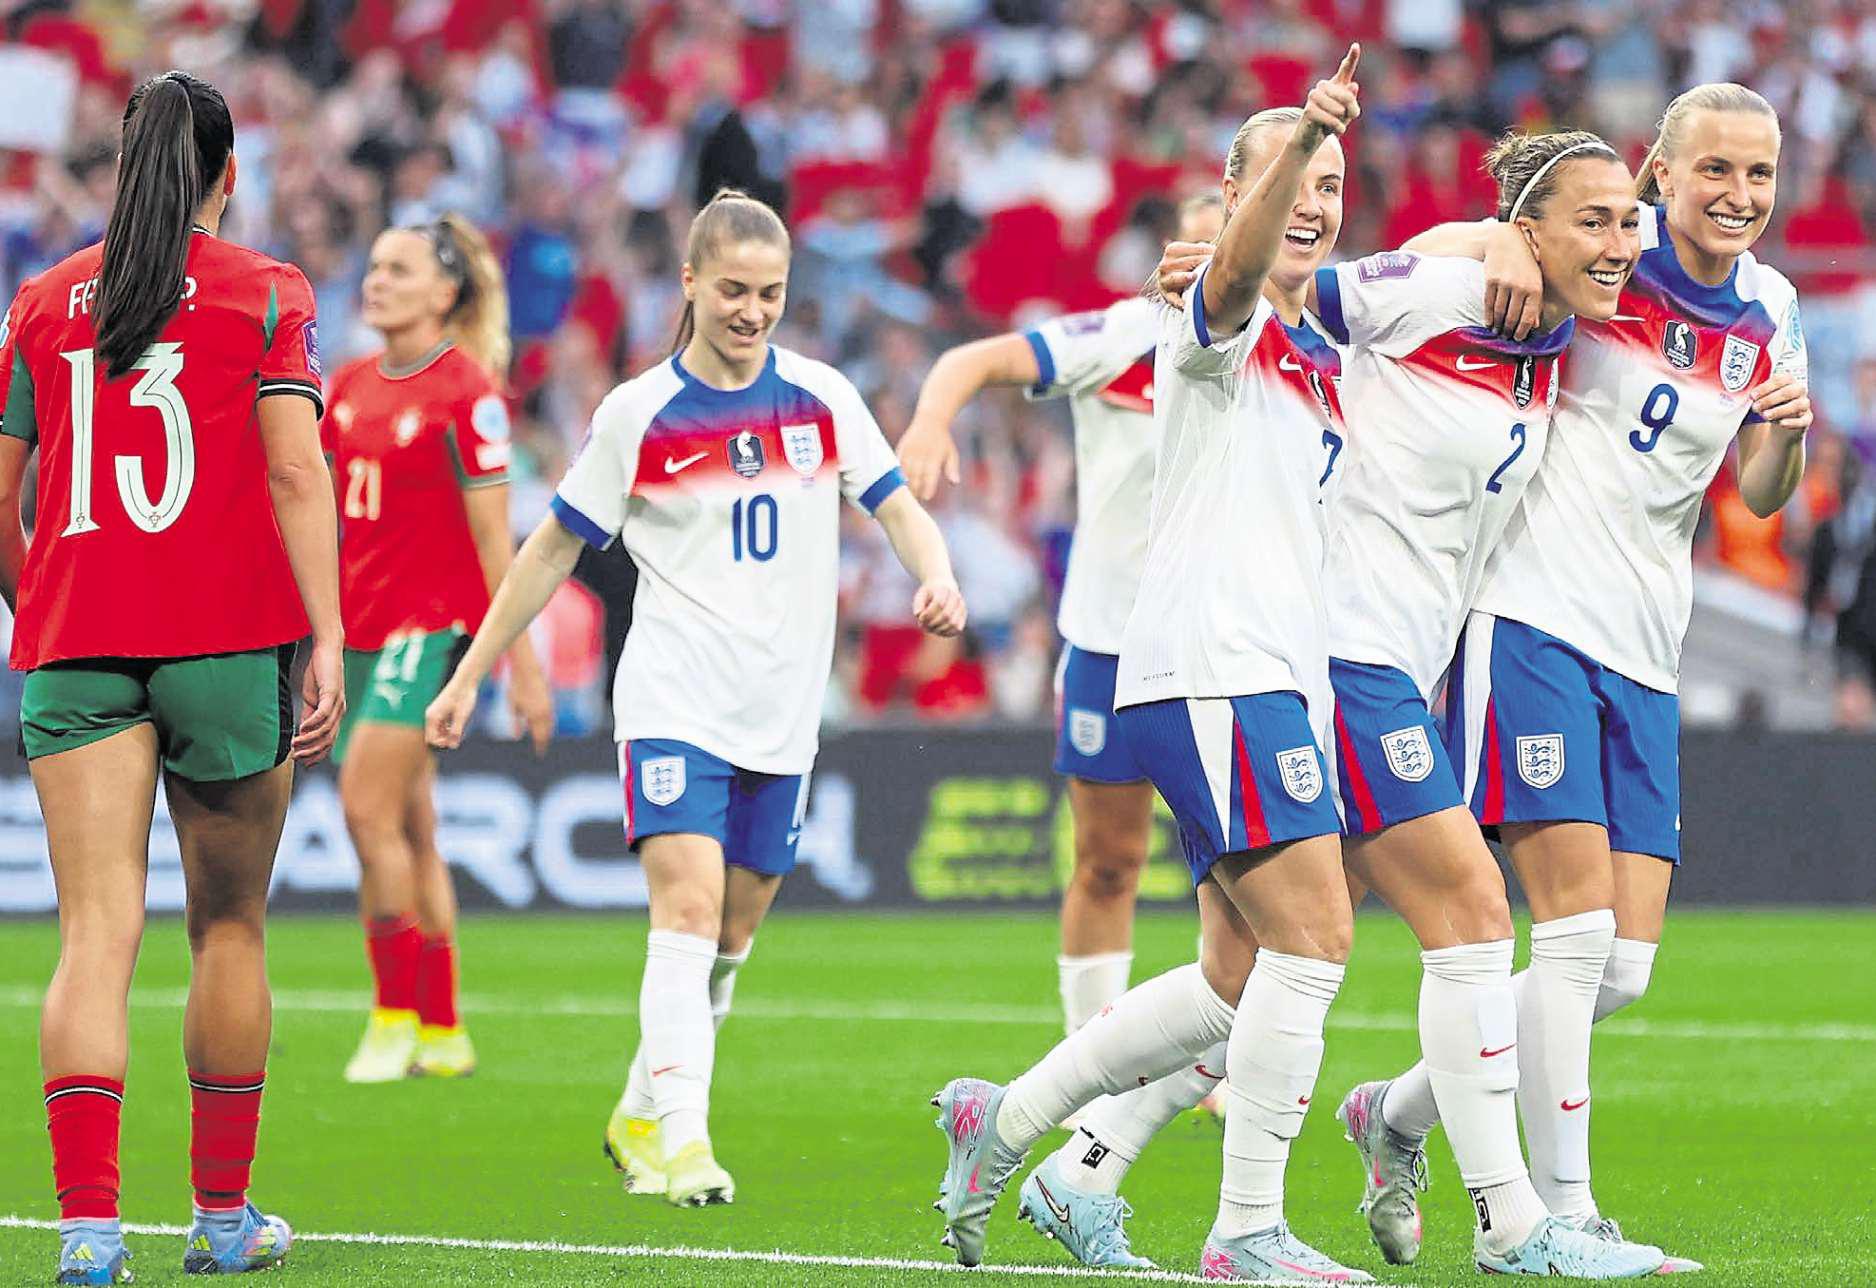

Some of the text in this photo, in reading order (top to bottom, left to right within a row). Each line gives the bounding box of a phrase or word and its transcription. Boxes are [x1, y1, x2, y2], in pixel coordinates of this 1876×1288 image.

[59, 342, 195, 538] 13
[1629, 383, 1679, 453] 9
[344, 457, 381, 520] 21
[1319, 429, 1343, 490] 7
[1485, 422, 1527, 494] 2
[732, 494, 778, 562] 10
[376, 627, 426, 682] 21
